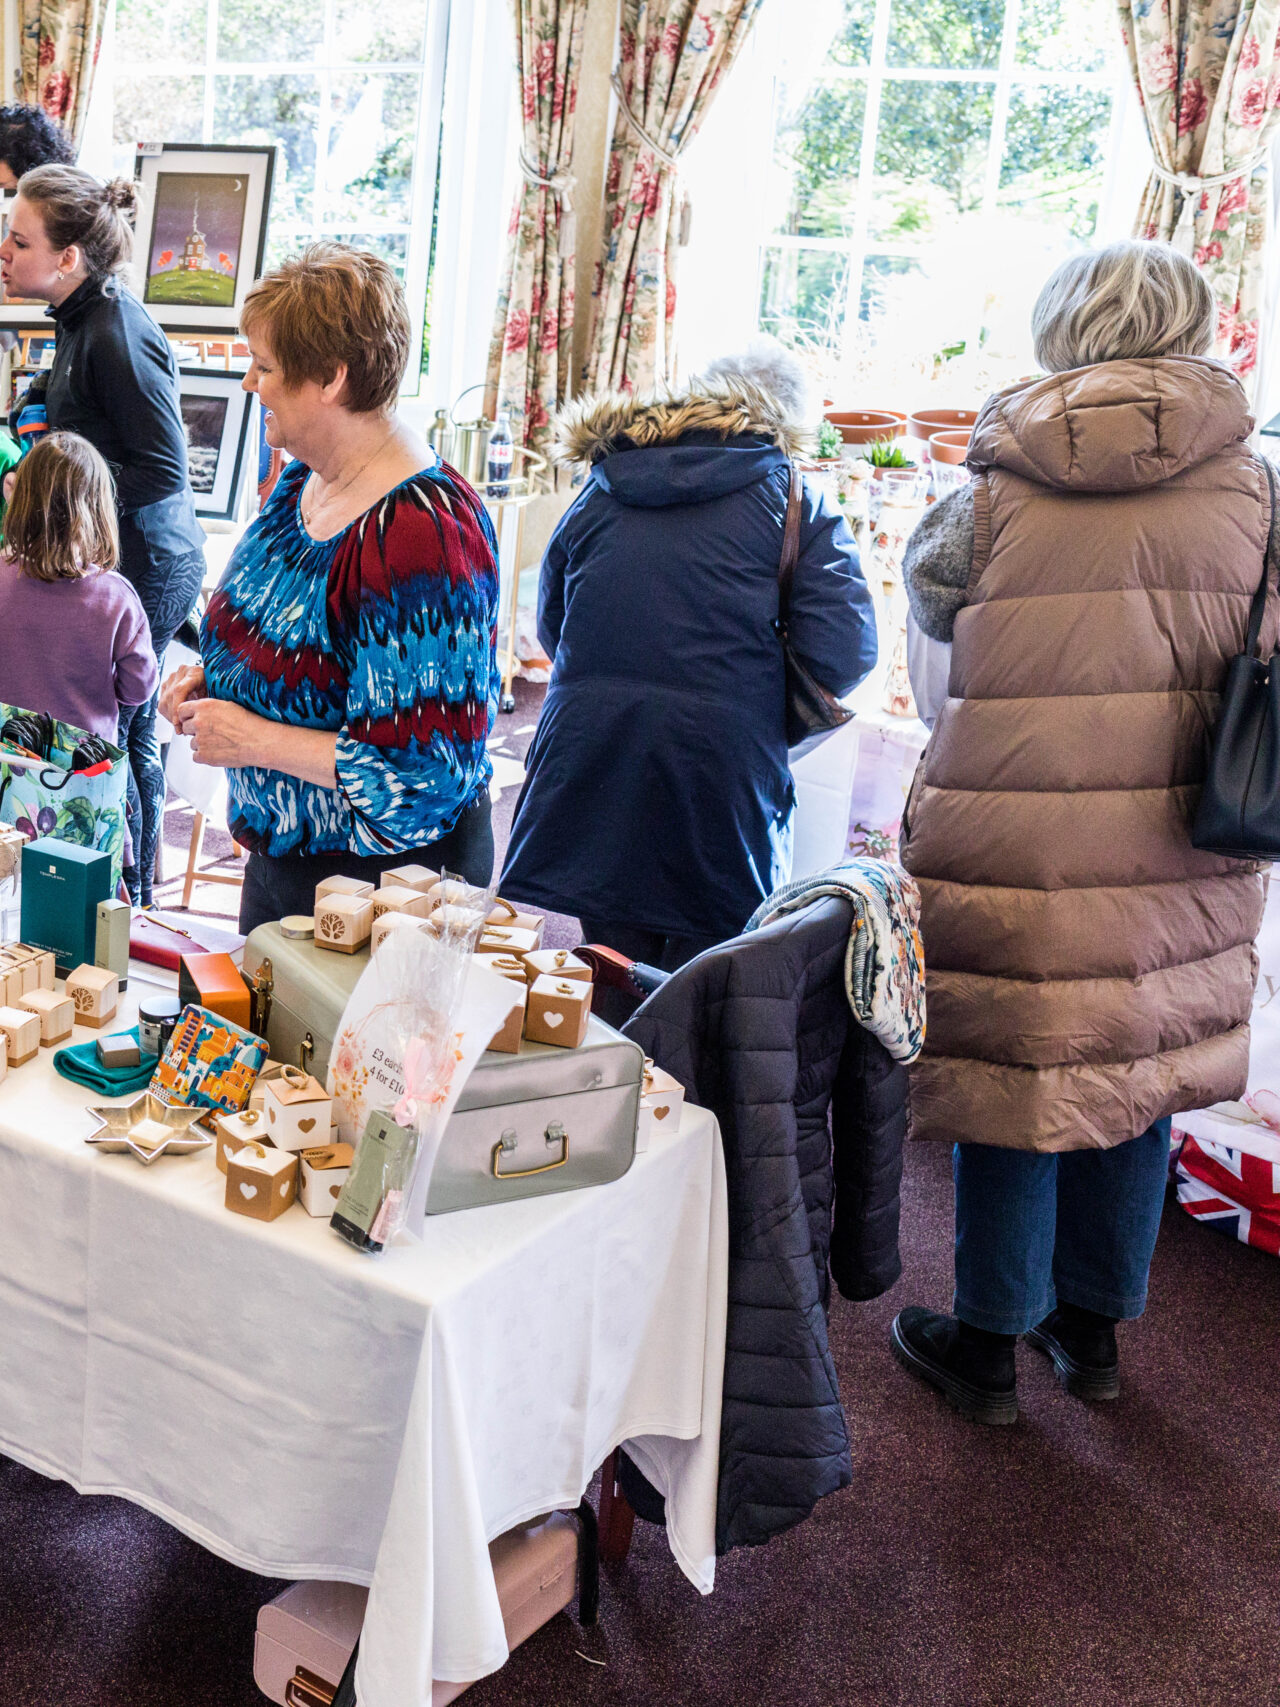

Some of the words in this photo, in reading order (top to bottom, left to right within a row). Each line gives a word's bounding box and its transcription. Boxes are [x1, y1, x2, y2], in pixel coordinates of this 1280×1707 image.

[372, 1047, 384, 1061] £3
[384, 1057, 403, 1075] each
[369, 1066, 376, 1077] 4
[376, 1069, 389, 1085] for
[388, 1078, 405, 1095] £10
